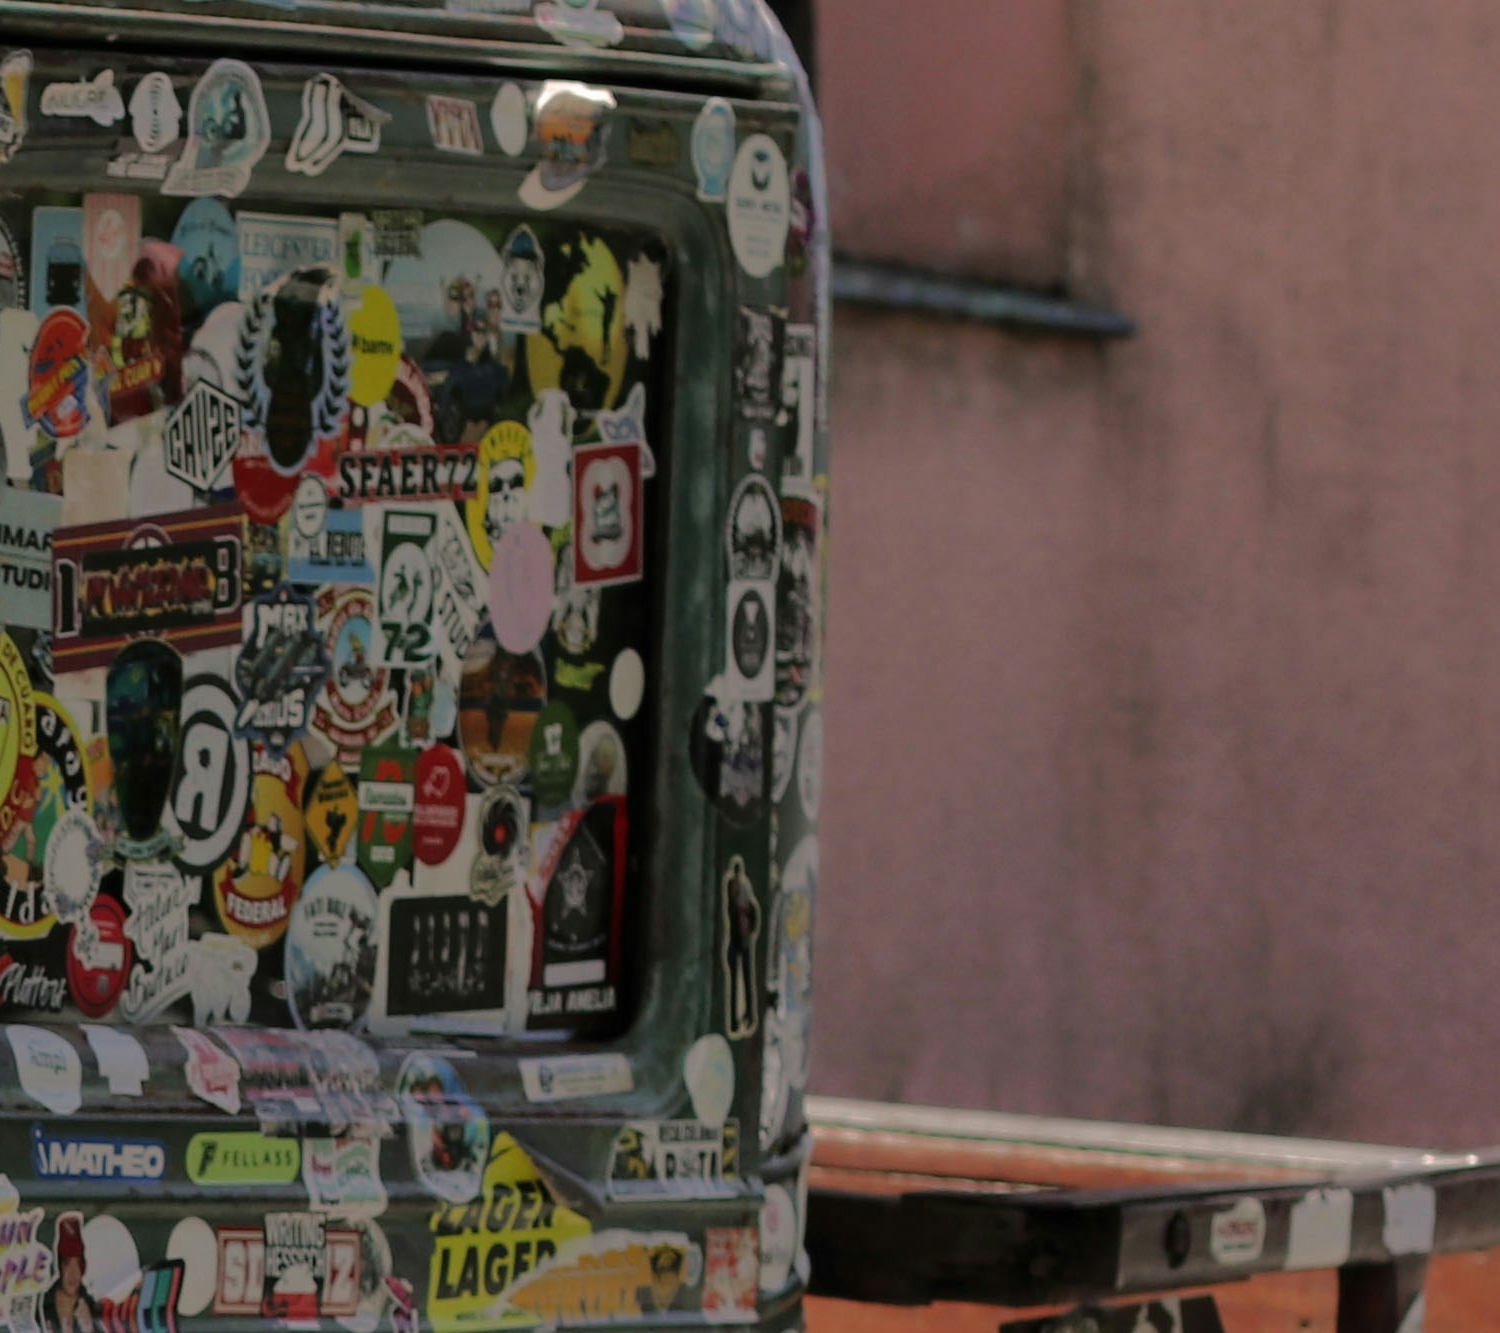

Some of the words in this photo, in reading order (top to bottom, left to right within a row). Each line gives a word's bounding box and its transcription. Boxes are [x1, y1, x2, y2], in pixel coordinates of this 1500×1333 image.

[339, 450, 477, 499] SFAER72
[383, 622, 430, 662] 72
[225, 894, 287, 925] FEDERAL
[223, 1148, 294, 1169] FELLASS
[266, 1214, 326, 1249] WRITING
[436, 1241, 556, 1299] LAGER
